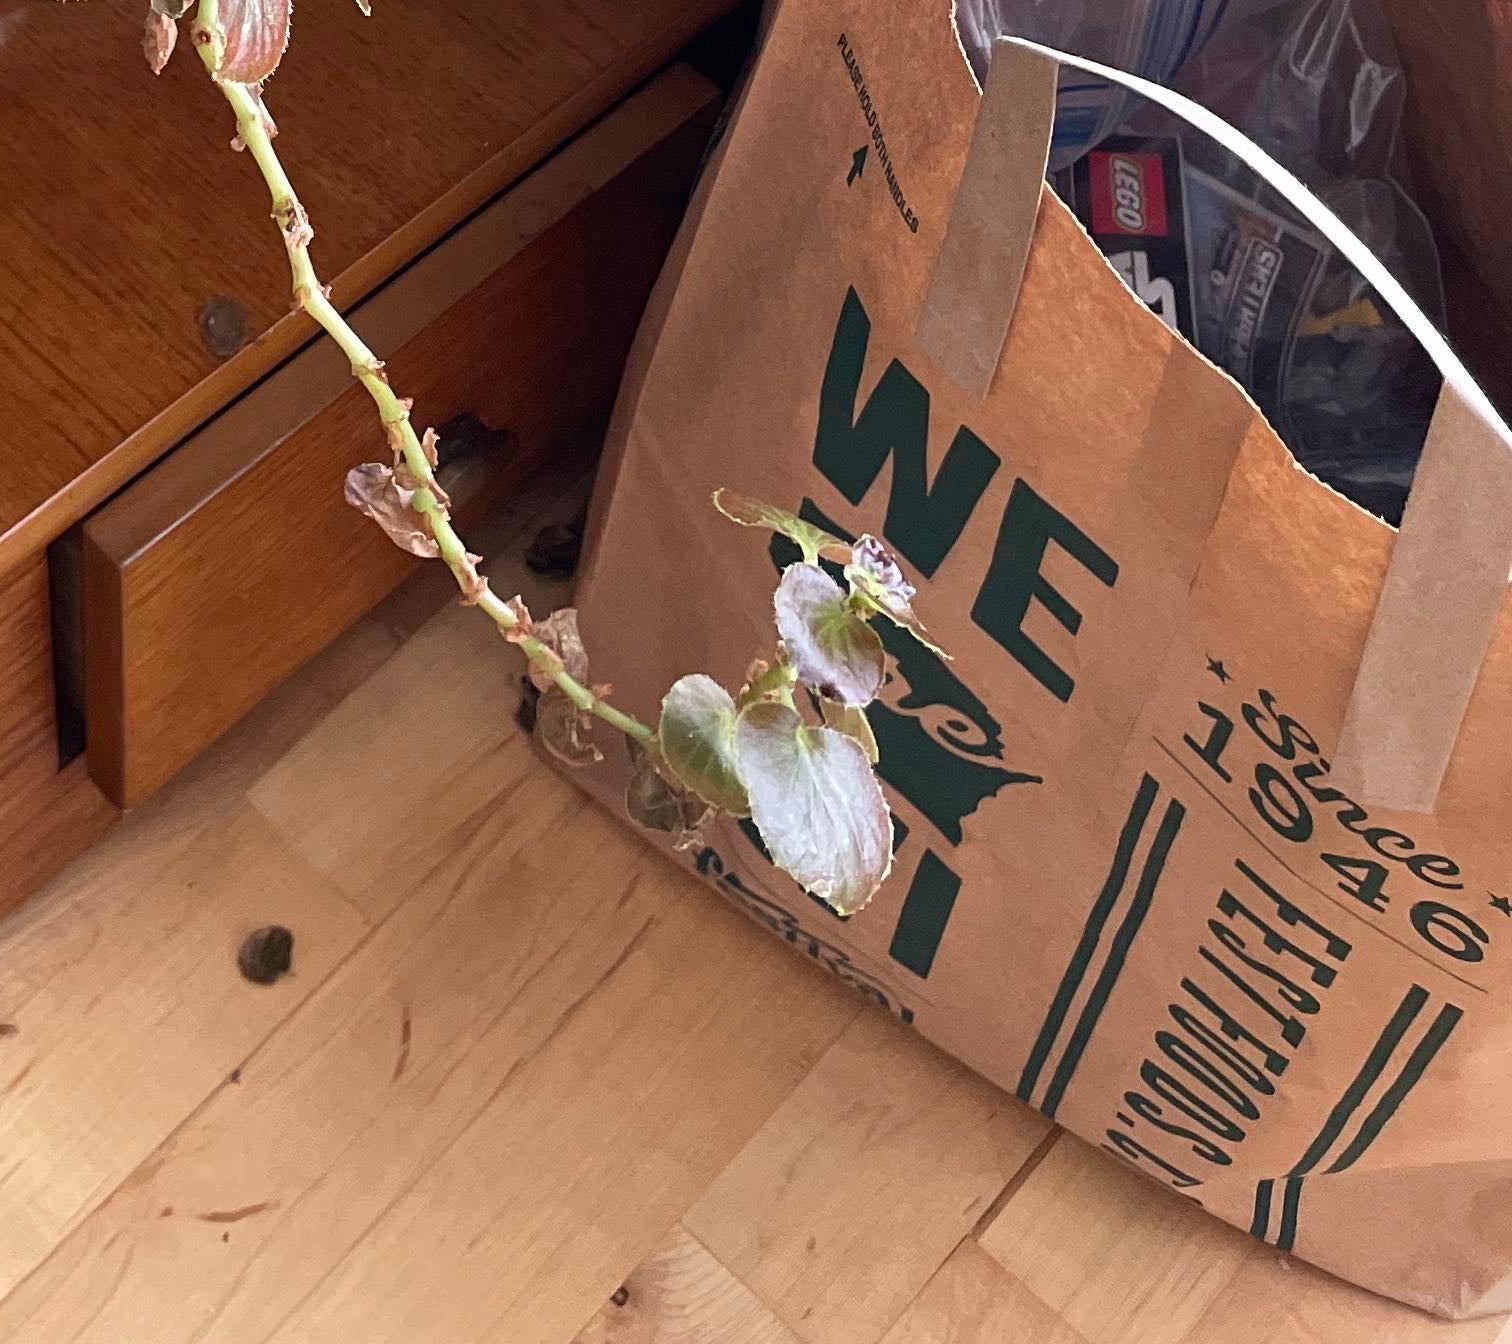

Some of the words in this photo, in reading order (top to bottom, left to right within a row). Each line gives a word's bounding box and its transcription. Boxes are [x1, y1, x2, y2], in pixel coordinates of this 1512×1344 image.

[837, 33, 863, 91] PLEASE
[857, 85, 878, 128] HOLD
[872, 123, 889, 169] BOTH
[884, 161, 920, 234] HANDLES
[1112, 158, 1145, 231] LEGO
[812, 284, 1120, 703] WE
[1183, 699, 1490, 963] 1946
[1241, 688, 1465, 890] Since
[1100, 857, 1353, 1206] FESTFOODS.C
